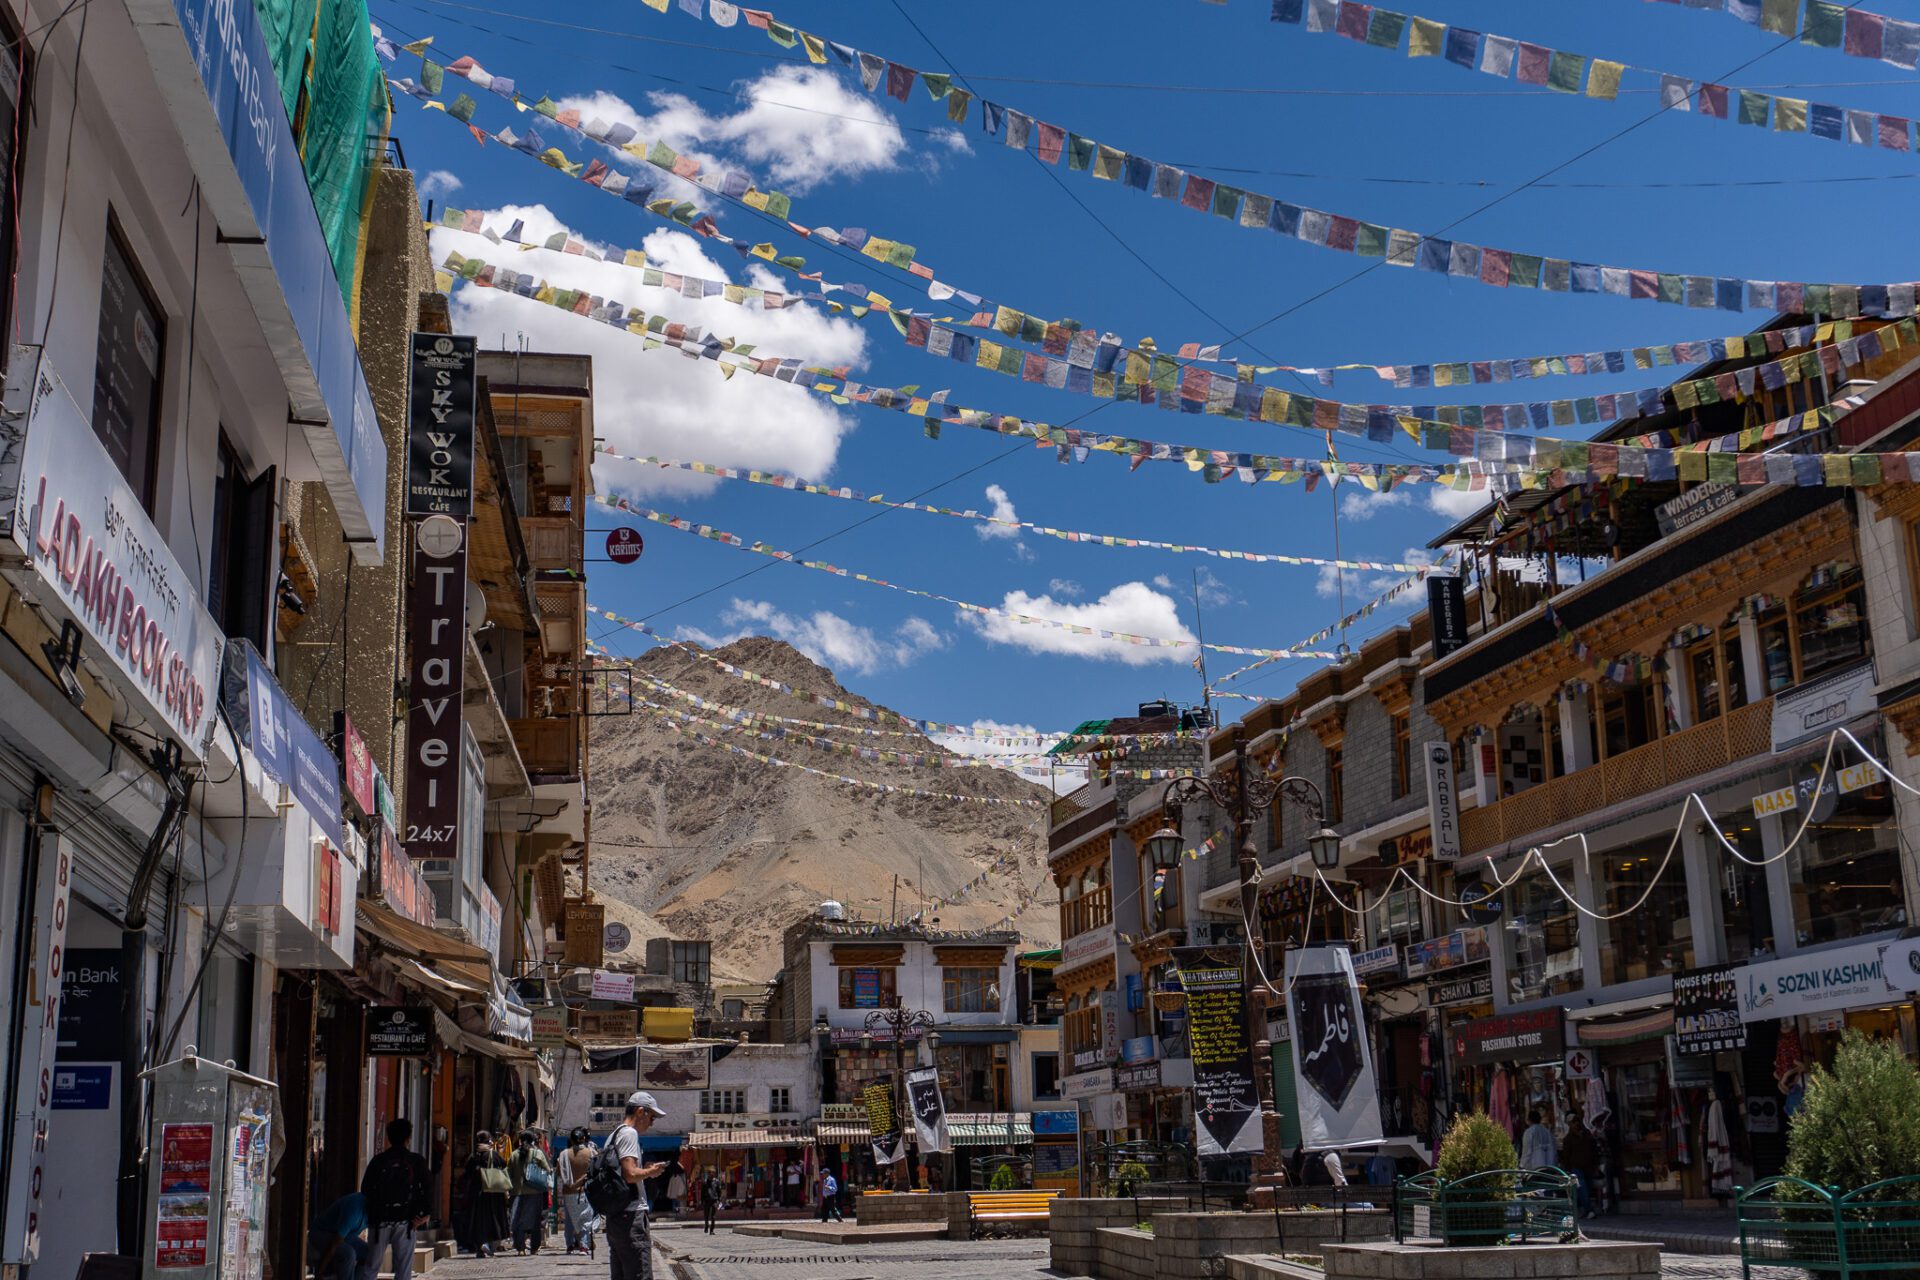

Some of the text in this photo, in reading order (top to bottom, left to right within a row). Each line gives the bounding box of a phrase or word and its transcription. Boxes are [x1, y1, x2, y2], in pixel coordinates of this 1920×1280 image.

[249, 66, 276, 183] Bank
[431, 370, 454, 423] SKY
[426, 432, 457, 485] WOK
[412, 485, 468, 497] RESTAURANT
[1673, 488, 1736, 529] terrace & café
[36, 473, 205, 735] LADAKH BOOK SHOP
[1441, 580, 1453, 638] WANDERERS
[419, 566, 455, 808] Travel
[1437, 768, 1453, 844] RABSAL
[1753, 788, 1795, 817] NAAS
[406, 824, 457, 843] 24x7
[46, 852, 68, 1030] BOOK
[80, 966, 120, 984] Bank
[1212, 970, 1239, 981] GANDHI
[1674, 976, 1700, 989] HOUSE
[1701, 973, 1712, 985] OF
[1777, 970, 1821, 995] SOZNI
[1440, 982, 1472, 1001] SHAKYA
[1801, 993, 1822, 1001] Threads
[1822, 992, 1829, 1000] of
[533, 1018, 558, 1026] SINGH
[370, 1033, 406, 1043] RESTAURANT
[1481, 1033, 1542, 1052] PASHMINA STORE
[1693, 1031, 1720, 1040] FACTORY
[1720, 1028, 1742, 1037] OUTLET
[701, 1118, 801, 1129] The Gift
[27, 1067, 49, 1247] SHOP
